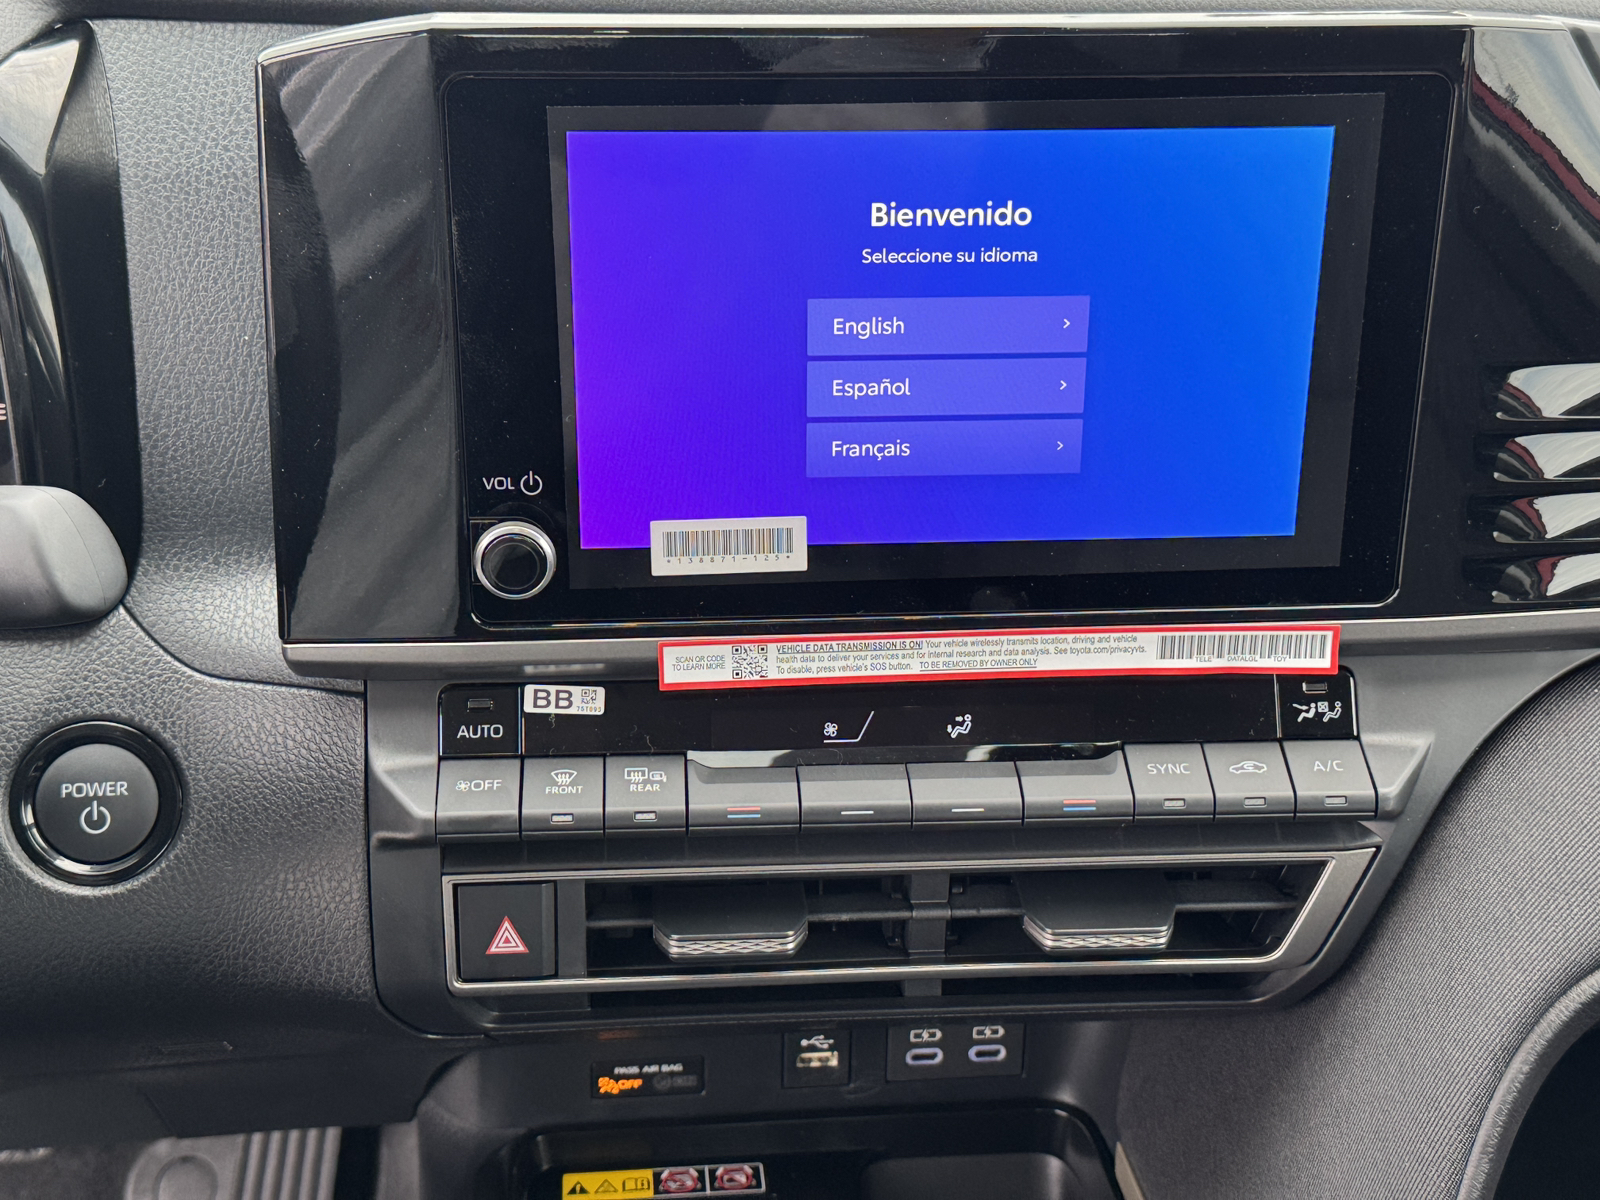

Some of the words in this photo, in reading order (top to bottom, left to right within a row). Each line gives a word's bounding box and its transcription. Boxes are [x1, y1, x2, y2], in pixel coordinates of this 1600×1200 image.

[870, 200, 1033, 227] Bienvenido
[861, 248, 953, 263] Seleccione
[956, 251, 975, 263] su
[980, 247, 1038, 262] idioma
[833, 316, 905, 339] English
[832, 378, 911, 400] Español
[831, 440, 911, 460] Français
[482, 477, 515, 490] VOL
[776, 643, 811, 653] VEHICLE
[813, 643, 834, 652] DATA
[836, 641, 897, 651] TRANSMISSION
[899, 640, 907, 649] IS
[925, 640, 942, 648] Your
[943, 639, 968, 647] vehicle
[970, 638, 1004, 648] wirelessly
[1006, 637, 1038, 645] transmits
[1040, 637, 1070, 645] location,
[1071, 636, 1095, 645] driving
[1097, 635, 1111, 643] and
[1112, 634, 1138, 643] vehicle
[694, 655, 705, 663] QR
[706, 654, 726, 662] CODE
[776, 655, 798, 664] health
[800, 655, 815, 663] data
[827, 653, 851, 662] deliver
[853, 654, 868, 663] your
[870, 652, 899, 661] services
[901, 651, 915, 659] and
[916, 651, 926, 659] for
[928, 650, 954, 658] internal
[956, 649, 987, 657] research
[988, 648, 1002, 656] and
[1004, 648, 1019, 656] data
[1021, 646, 1052, 656] analysis.
[1054, 646, 1068, 655] See
[682, 663, 705, 671] LEARN
[706, 662, 726, 670] MORE
[776, 666, 785, 674] To
[787, 665, 814, 675] disable,
[816, 665, 836, 674] press
[838, 663, 868, 672] vehicle's
[870, 662, 887, 671] SOS
[889, 662, 913, 671] button.
[919, 661, 929, 669] TO
[931, 660, 940, 669] BE
[942, 660, 978, 668] REMOVED
[980, 659, 989, 667] BY
[990, 659, 1017, 667] OWNER
[1018, 658, 1038, 666] ONLY
[532, 689, 573, 709] BB
[457, 724, 504, 739] AUTO
[1147, 763, 1191, 775] SYNC
[1313, 760, 1344, 772] A/C
[61, 781, 129, 798] POWER
[471, 779, 502, 791] OFF
[545, 785, 583, 795] FRONT
[629, 783, 661, 792] REAR
